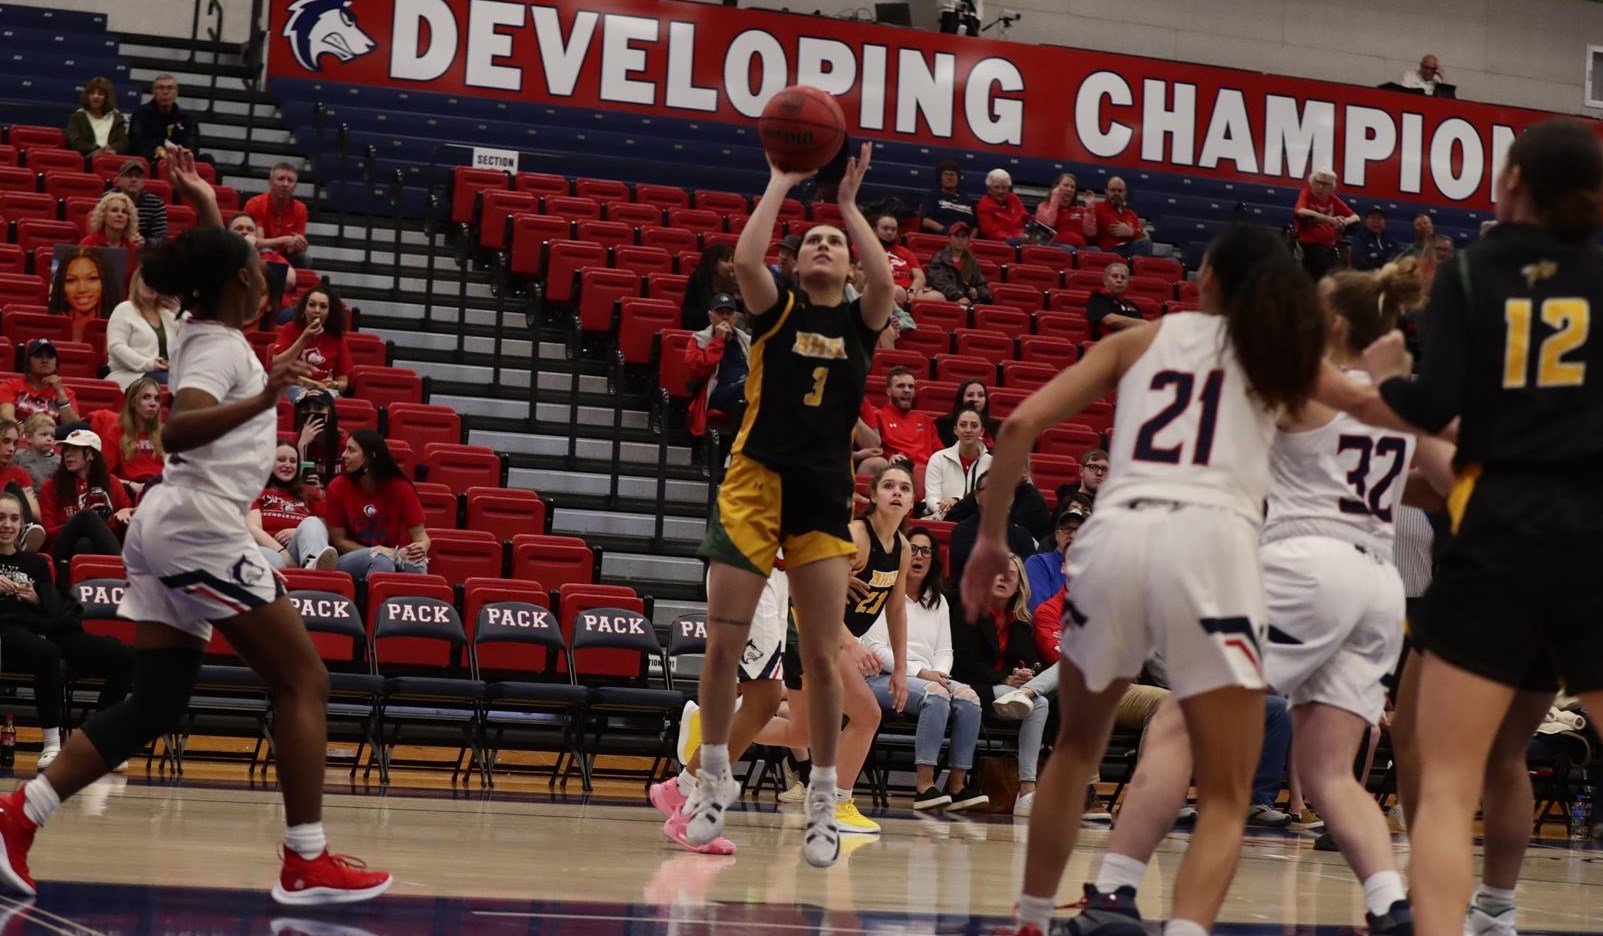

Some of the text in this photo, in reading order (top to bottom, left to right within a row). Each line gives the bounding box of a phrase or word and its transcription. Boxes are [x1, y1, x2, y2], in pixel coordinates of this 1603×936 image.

[389, 0, 1025, 146] DEVELOPING
[477, 154, 515, 167] SECTION
[1502, 298, 1590, 388] 12
[803, 366, 829, 406] 3
[1132, 368, 1225, 467] 21
[1337, 434, 1407, 523] 32
[80, 586, 124, 605] PAC
[387, 603, 450, 623] PACK
[486, 608, 549, 628] PACK
[584, 615, 645, 634] PACK
[681, 621, 708, 638] PA
